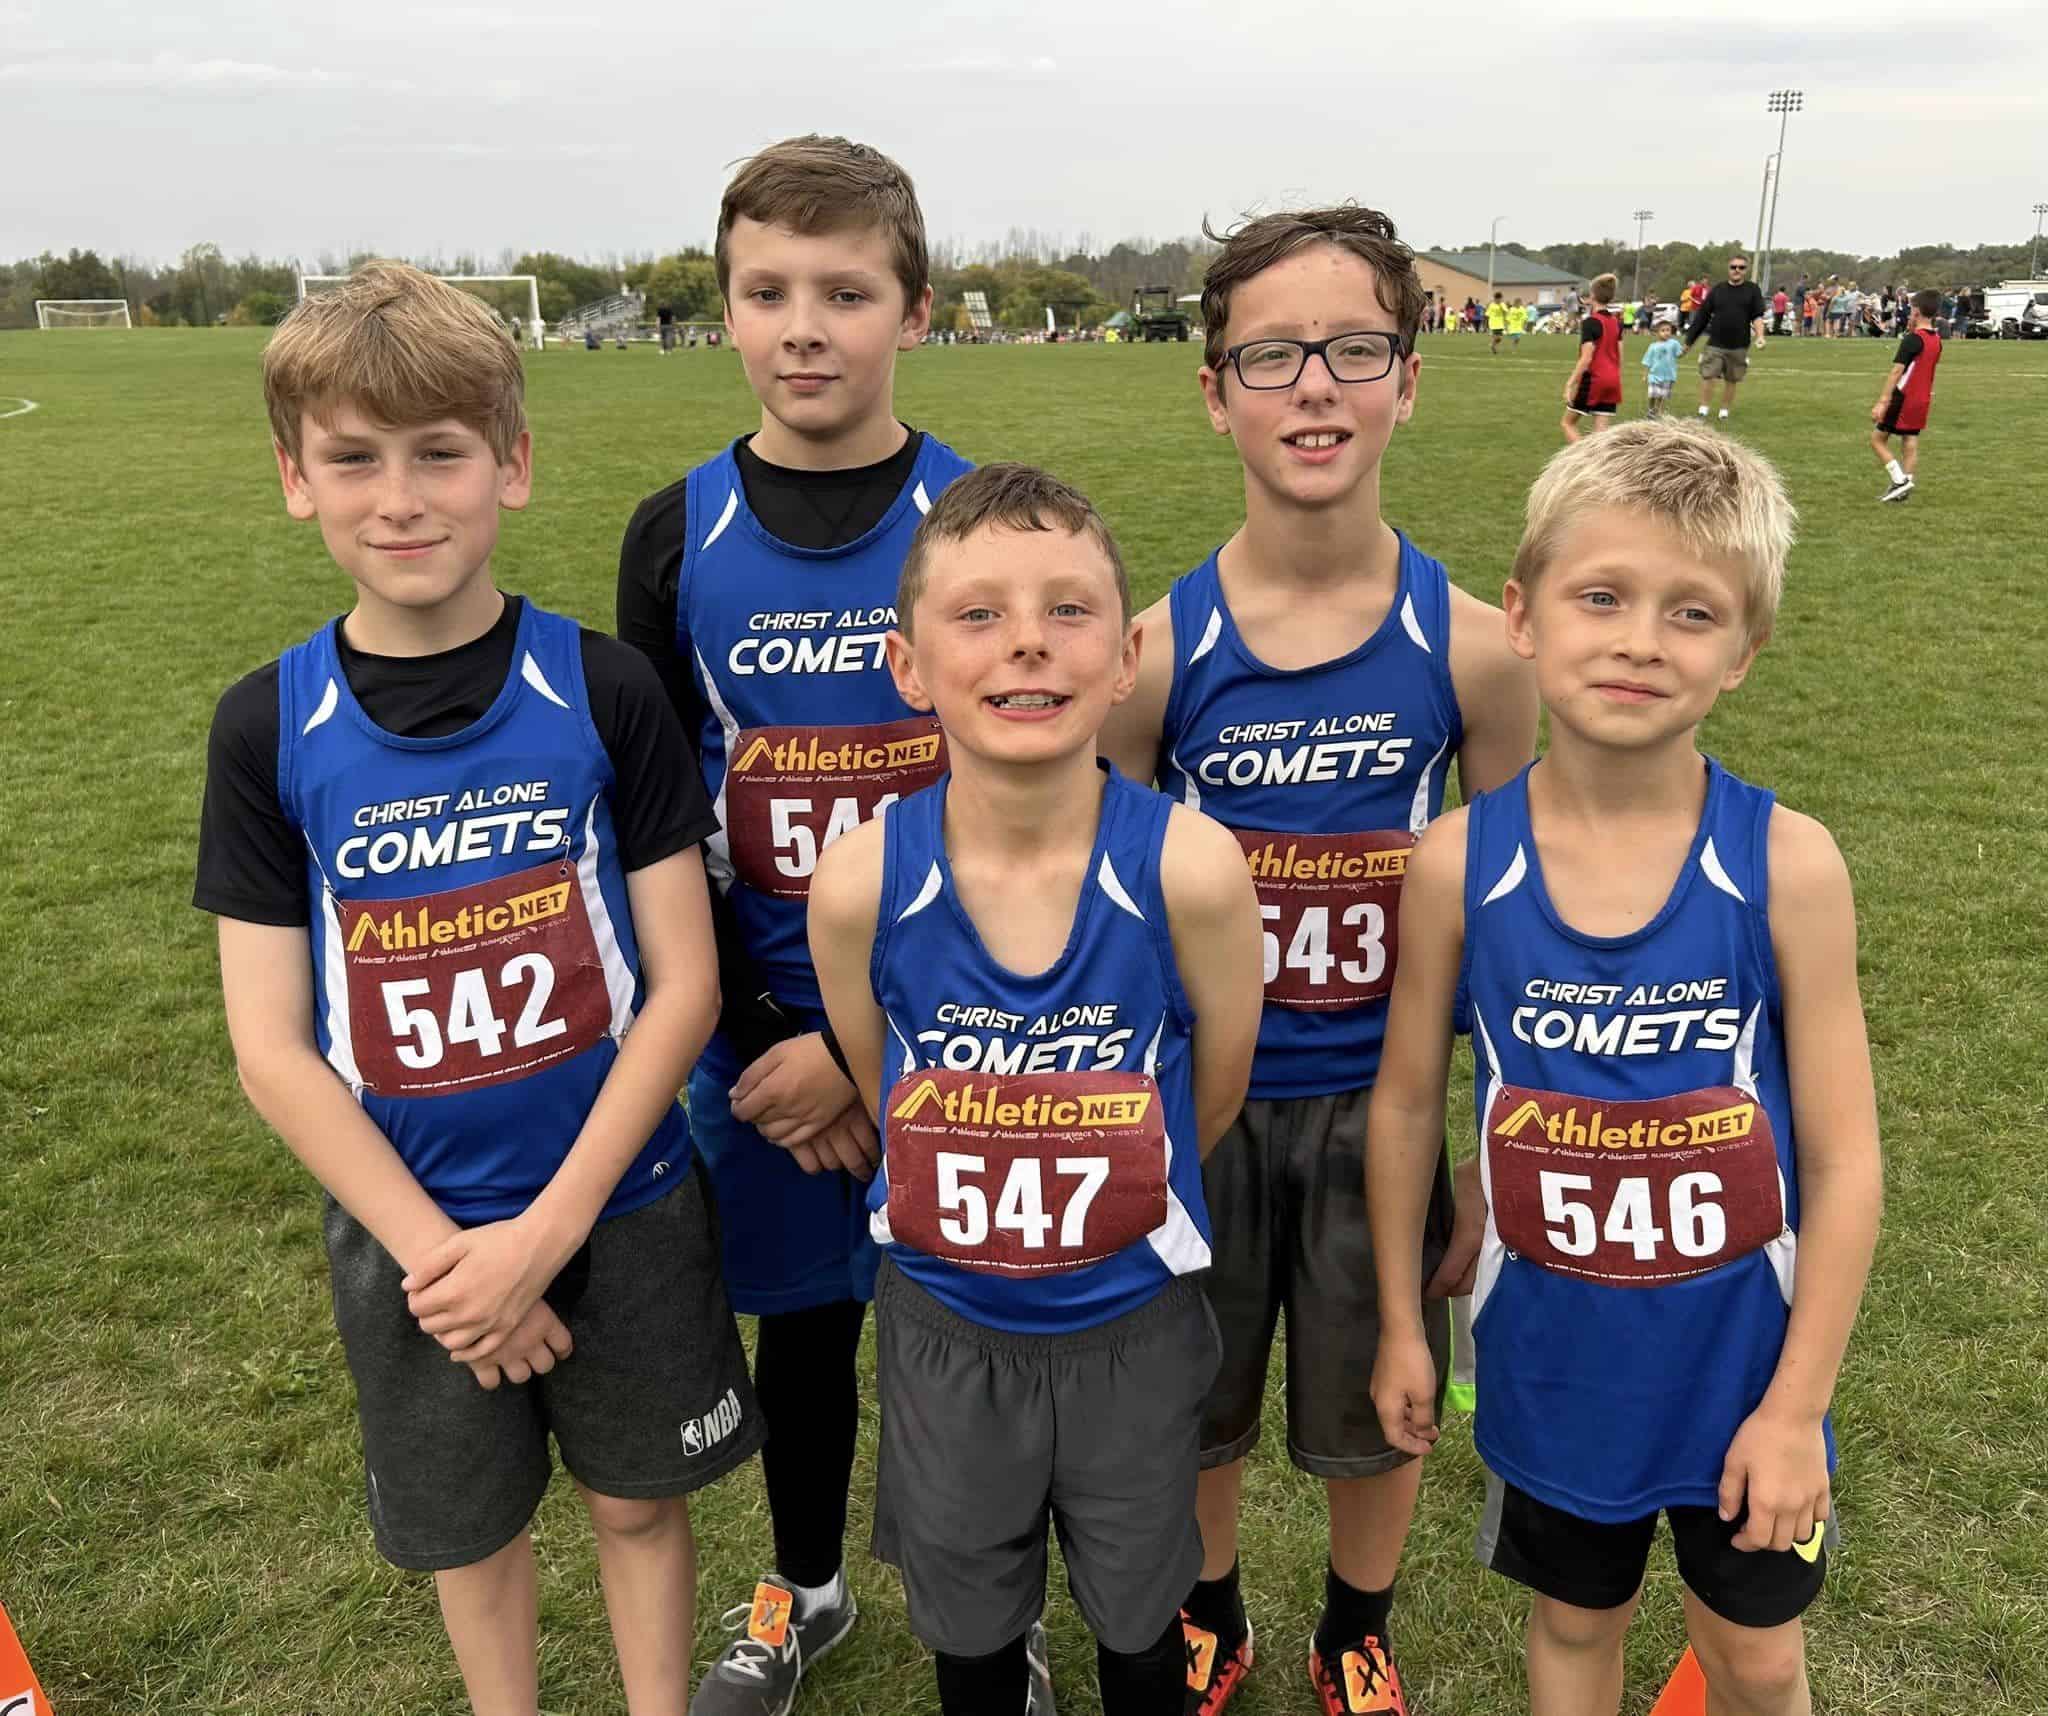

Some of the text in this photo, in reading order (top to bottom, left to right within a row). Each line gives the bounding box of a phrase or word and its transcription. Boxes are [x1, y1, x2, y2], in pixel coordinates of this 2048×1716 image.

[748, 607, 899, 631] CHRIST ALON
[728, 632, 887, 675] COMET
[1218, 712, 1396, 745] CHRIST ALONE
[1199, 737, 1413, 787] COMETS
[353, 781, 549, 828] CHRIST ALONE
[335, 808, 569, 879] COMETS
[769, 791, 899, 878] 54
[1248, 842, 1363, 879] thletic
[380, 952, 568, 1070] 542
[1525, 978, 1728, 1007] CHRIST ALONE
[936, 1003, 1118, 1036] CHRIST ALONE
[1512, 1005, 1741, 1056] COMETS
[935, 1151, 1111, 1249] 547
[1538, 1169, 1727, 1262] 546
[703, 1387, 743, 1448] NBA
